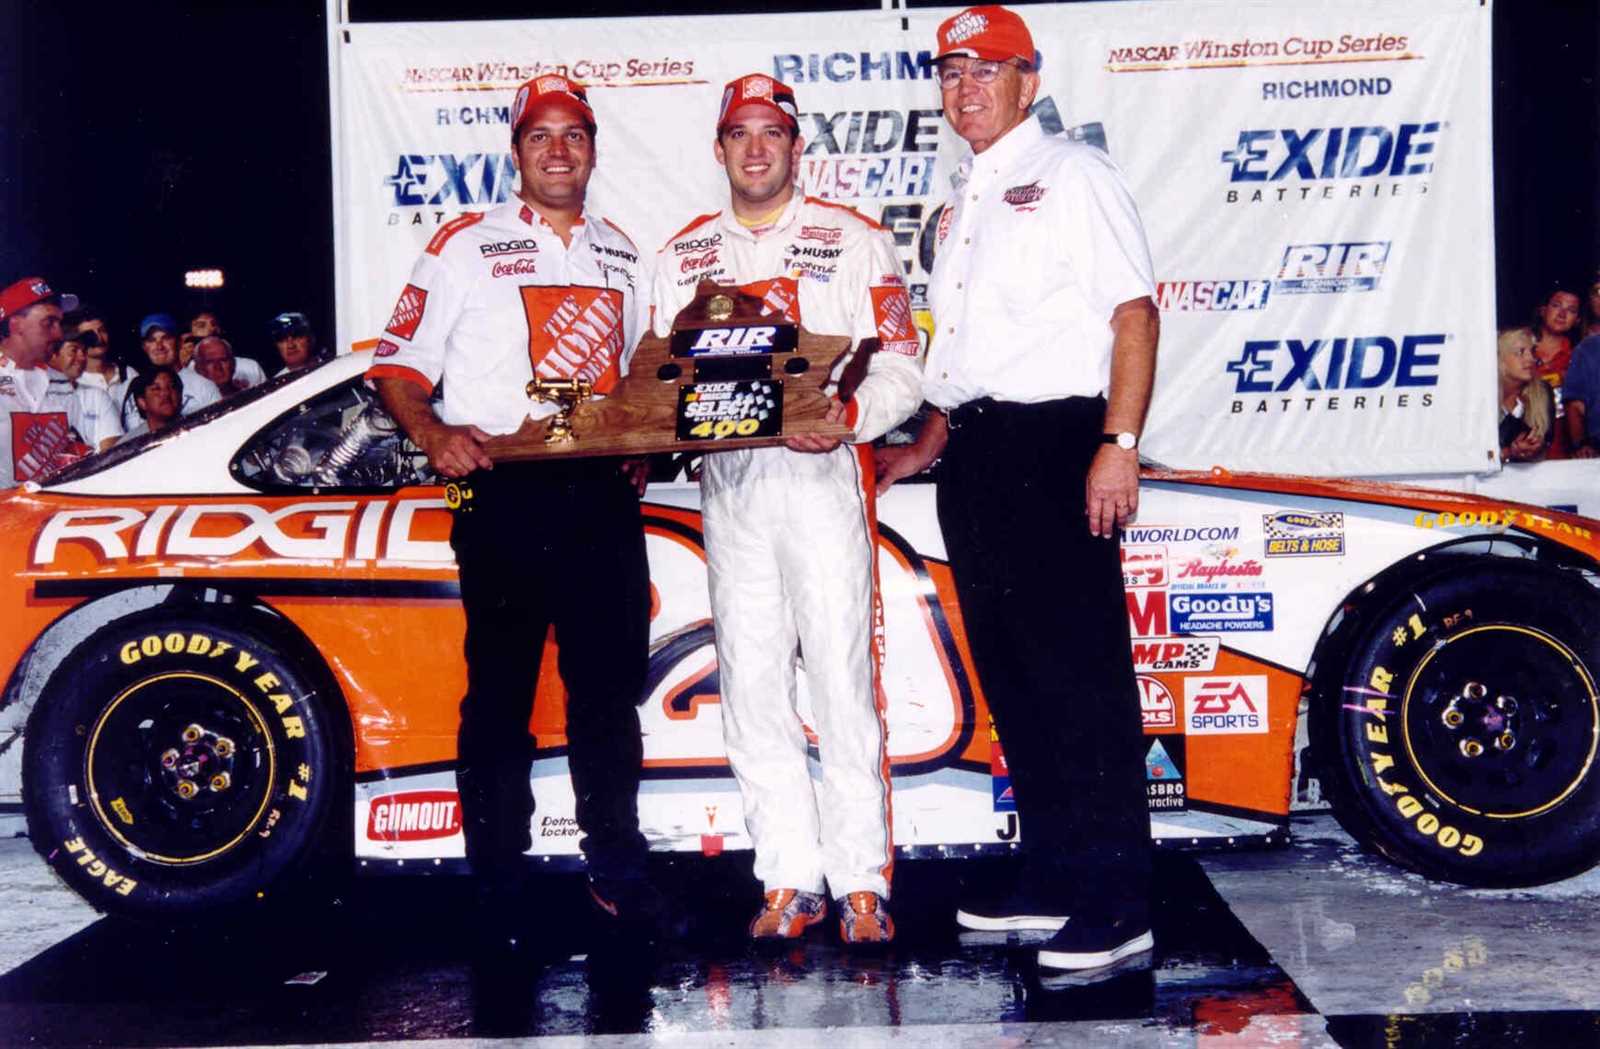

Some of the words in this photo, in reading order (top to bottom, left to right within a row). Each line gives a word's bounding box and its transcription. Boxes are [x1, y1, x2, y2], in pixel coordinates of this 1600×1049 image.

[1106, 45, 1179, 64] NASCAR
[1183, 37, 1279, 60] Winston
[1283, 36, 1333, 61] Cup
[1337, 32, 1408, 55] Series
[403, 65, 473, 83] NASCAR
[572, 59, 621, 81] Cup
[626, 56, 695, 78] Series
[1262, 76, 1392, 101] RICHMOND
[1221, 121, 1440, 183] EXIDE
[1226, 182, 1429, 203] BATTERIES
[387, 211, 470, 225] BAT
[479, 238, 537, 256] RIDGID
[604, 246, 638, 264] HUSKY
[803, 247, 844, 259] HUSKY
[1157, 280, 1272, 311] NASCAR
[690, 326, 777, 349] RIR
[1226, 333, 1447, 394] EXIDE
[684, 397, 754, 419] SELECT
[1230, 393, 1434, 414] BATTERIES
[689, 418, 760, 438] 400
[1130, 526, 1240, 543] WORLDCOM
[1414, 508, 1595, 541] GOODYEAR
[1268, 540, 1299, 553] BELTS
[1300, 540, 1310, 552] &
[1311, 539, 1341, 552] HOSE
[1176, 558, 1264, 583] Raybestos
[1172, 595, 1272, 621] Goody's
[1180, 620, 1223, 631] HEADACHE
[1224, 620, 1265, 630] POWDERS
[1392, 613, 1427, 648] #1
[1152, 659, 1201, 670] CAMS
[119, 632, 306, 740] GOODYEAR
[1193, 682, 1259, 714] EA
[1191, 714, 1259, 729] SPORTS
[1365, 665, 1484, 857] GOODYEAR
[287, 762, 311, 802] #1
[374, 800, 458, 833] GUMOUT
[540, 827, 581, 838] Locker
[63, 835, 138, 896] EAGLE
